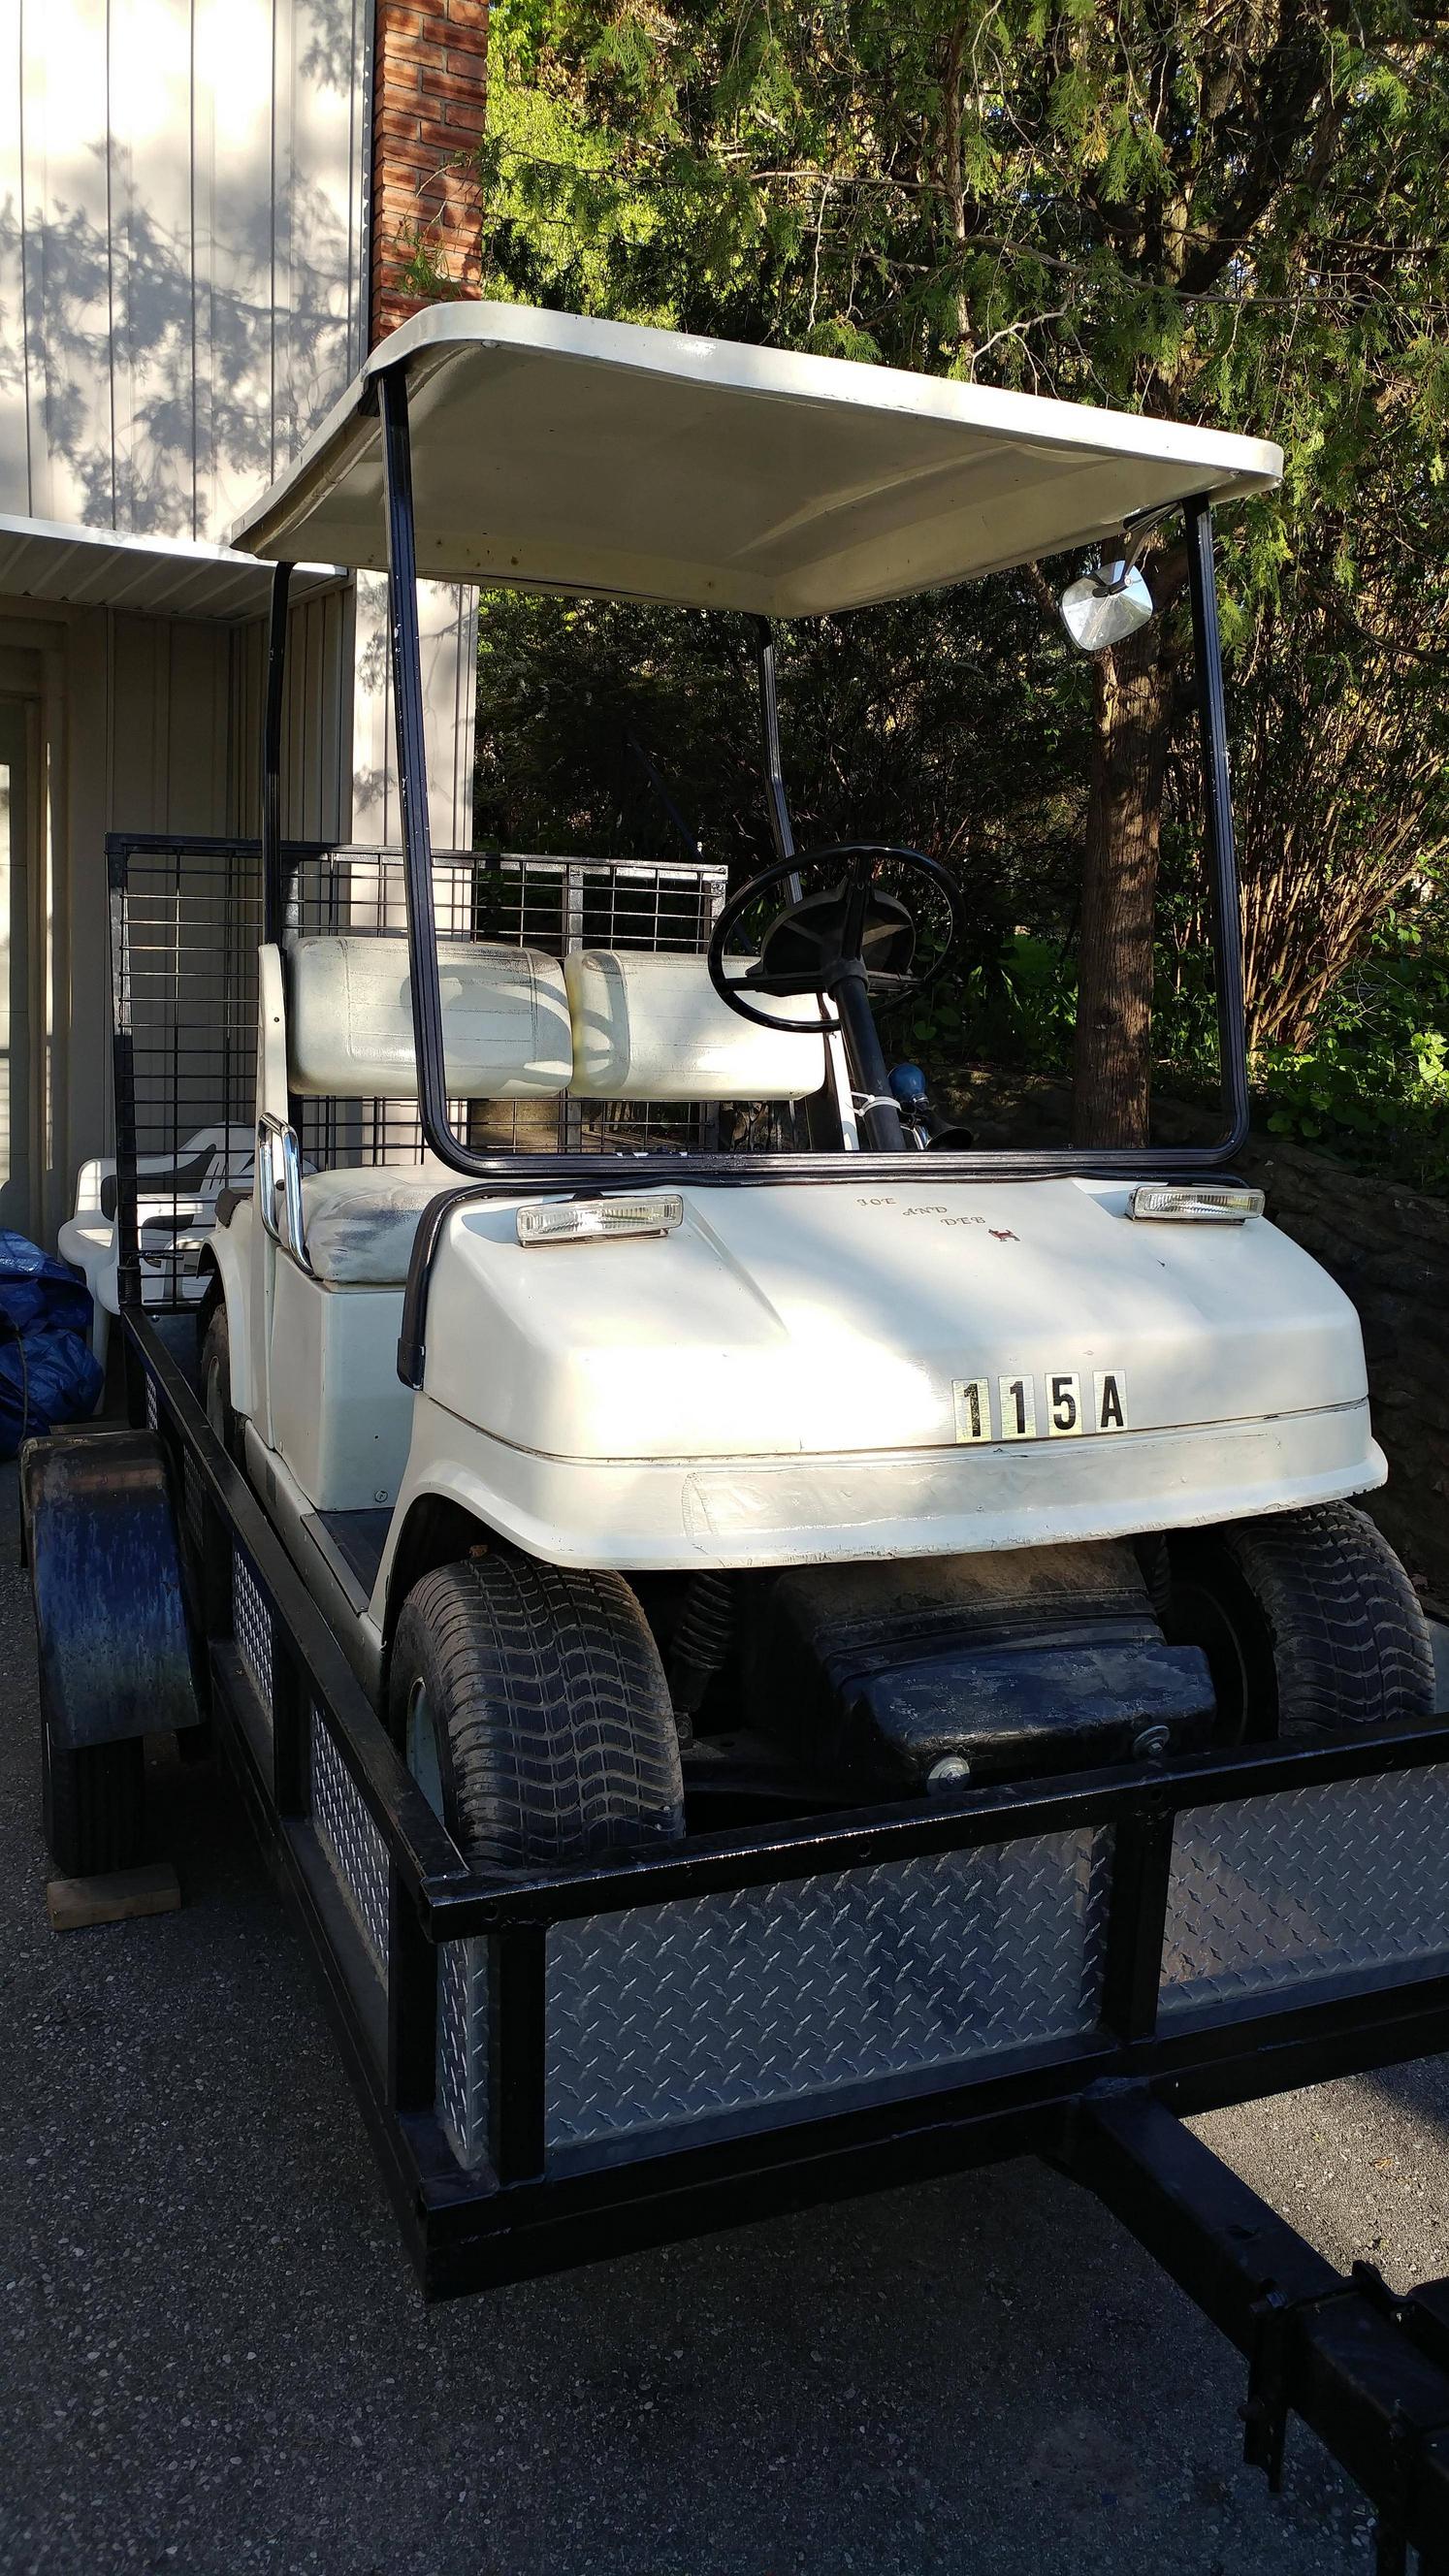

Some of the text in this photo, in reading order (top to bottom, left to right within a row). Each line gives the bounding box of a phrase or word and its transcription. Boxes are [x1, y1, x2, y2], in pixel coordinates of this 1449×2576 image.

[856, 1197, 896, 1206] JOE
[902, 1206, 948, 1215] AND
[940, 1216, 986, 1226] DEB
[963, 1375, 1124, 1437] 115A
